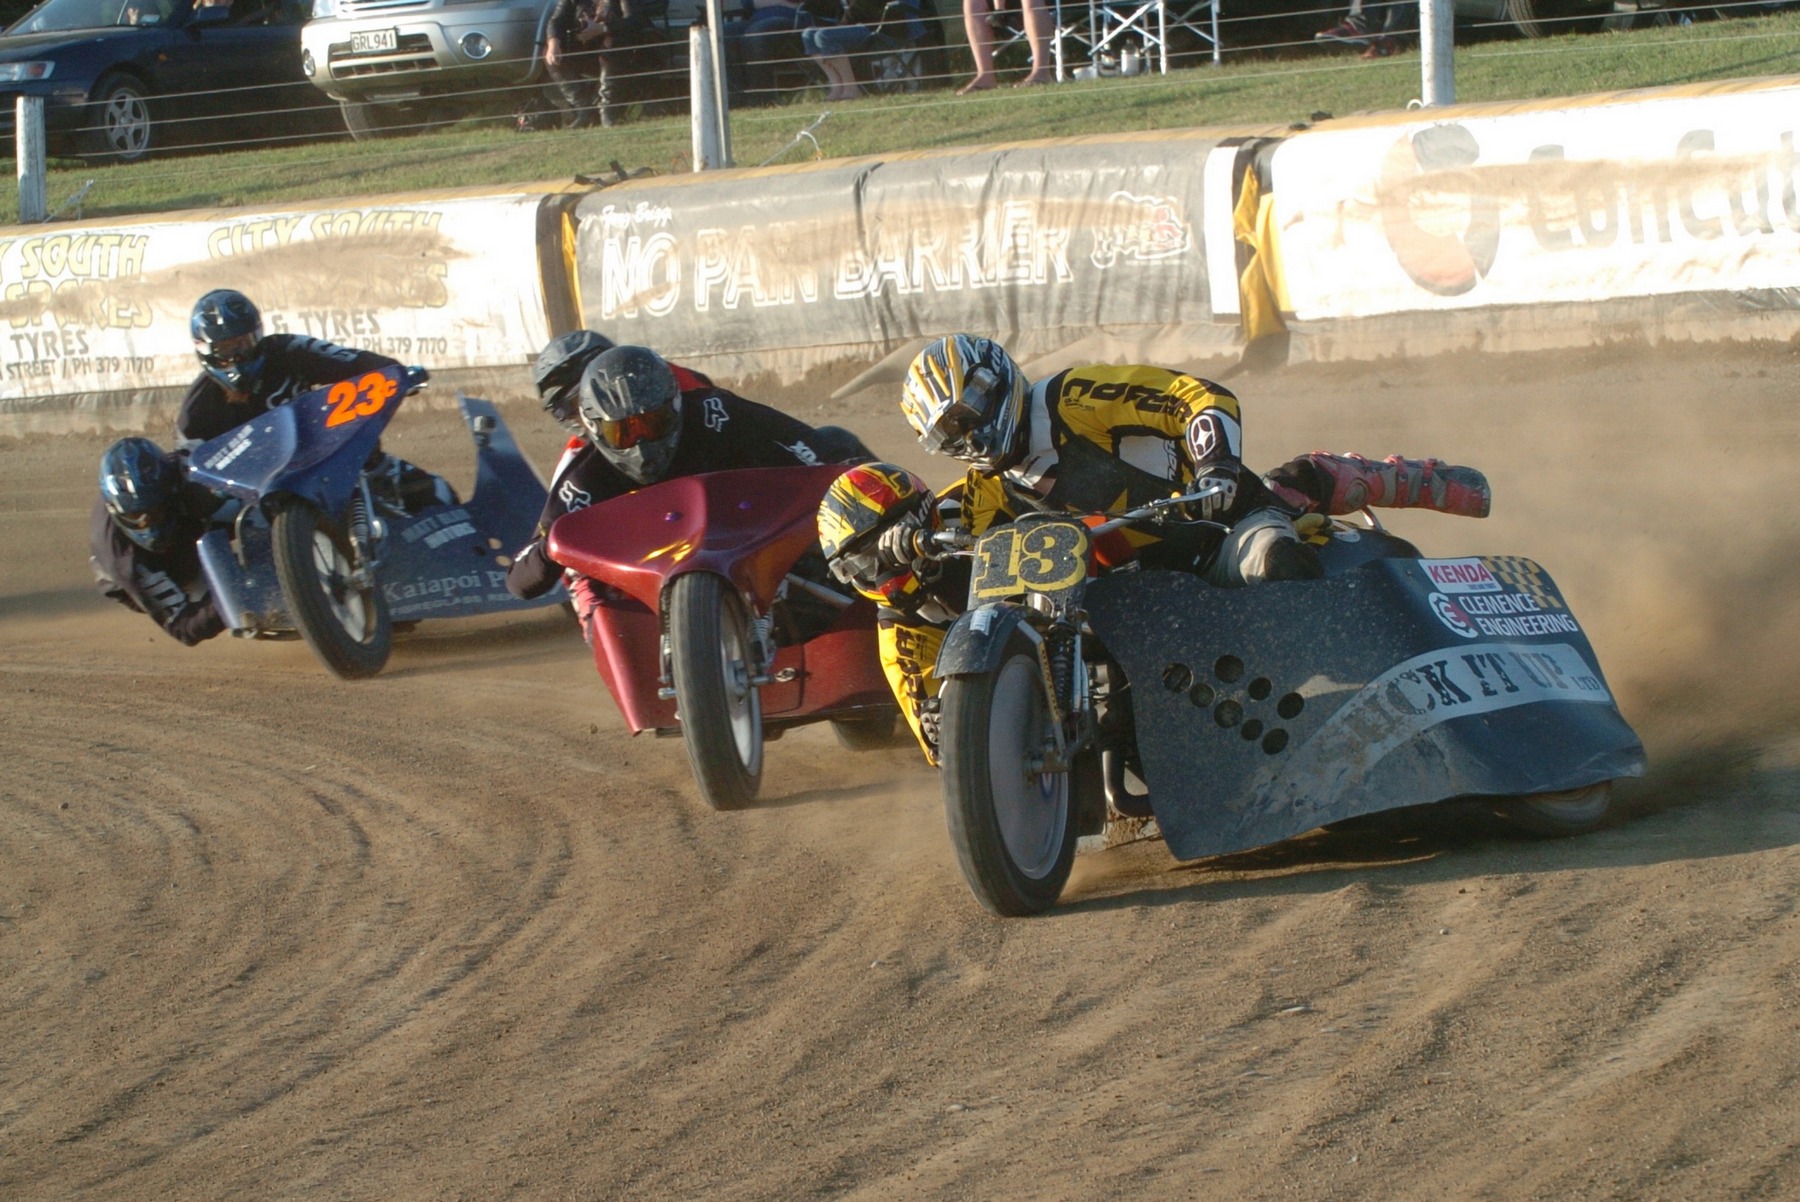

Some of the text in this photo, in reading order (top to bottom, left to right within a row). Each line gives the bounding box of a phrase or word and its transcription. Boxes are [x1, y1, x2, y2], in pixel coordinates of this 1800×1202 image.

[352, 33, 394, 51] GRL941
[207, 216, 304, 260] CITY
[20, 234, 149, 279] SOUTH
[601, 231, 681, 320] NO
[694, 219, 819, 312] PAIN
[834, 199, 1074, 300] BARRIER
[298, 308, 382, 338] TYRES
[10, 329, 90, 360] TYRES
[386, 337, 413, 355] 379
[416, 336, 448, 355] 7170
[5, 358, 56, 381] STREET
[73, 356, 92, 375] PH
[96, 355, 120, 372] 379
[124, 355, 155, 372] 7170
[973, 522, 1089, 599] 13
[1427, 563, 1494, 584] KENDA
[382, 570, 482, 603] Kaiapoi
[1458, 592, 1542, 615] CLEMENCE
[1478, 613, 1579, 637] ENGINEERING
[1460, 652, 1521, 697] IT
